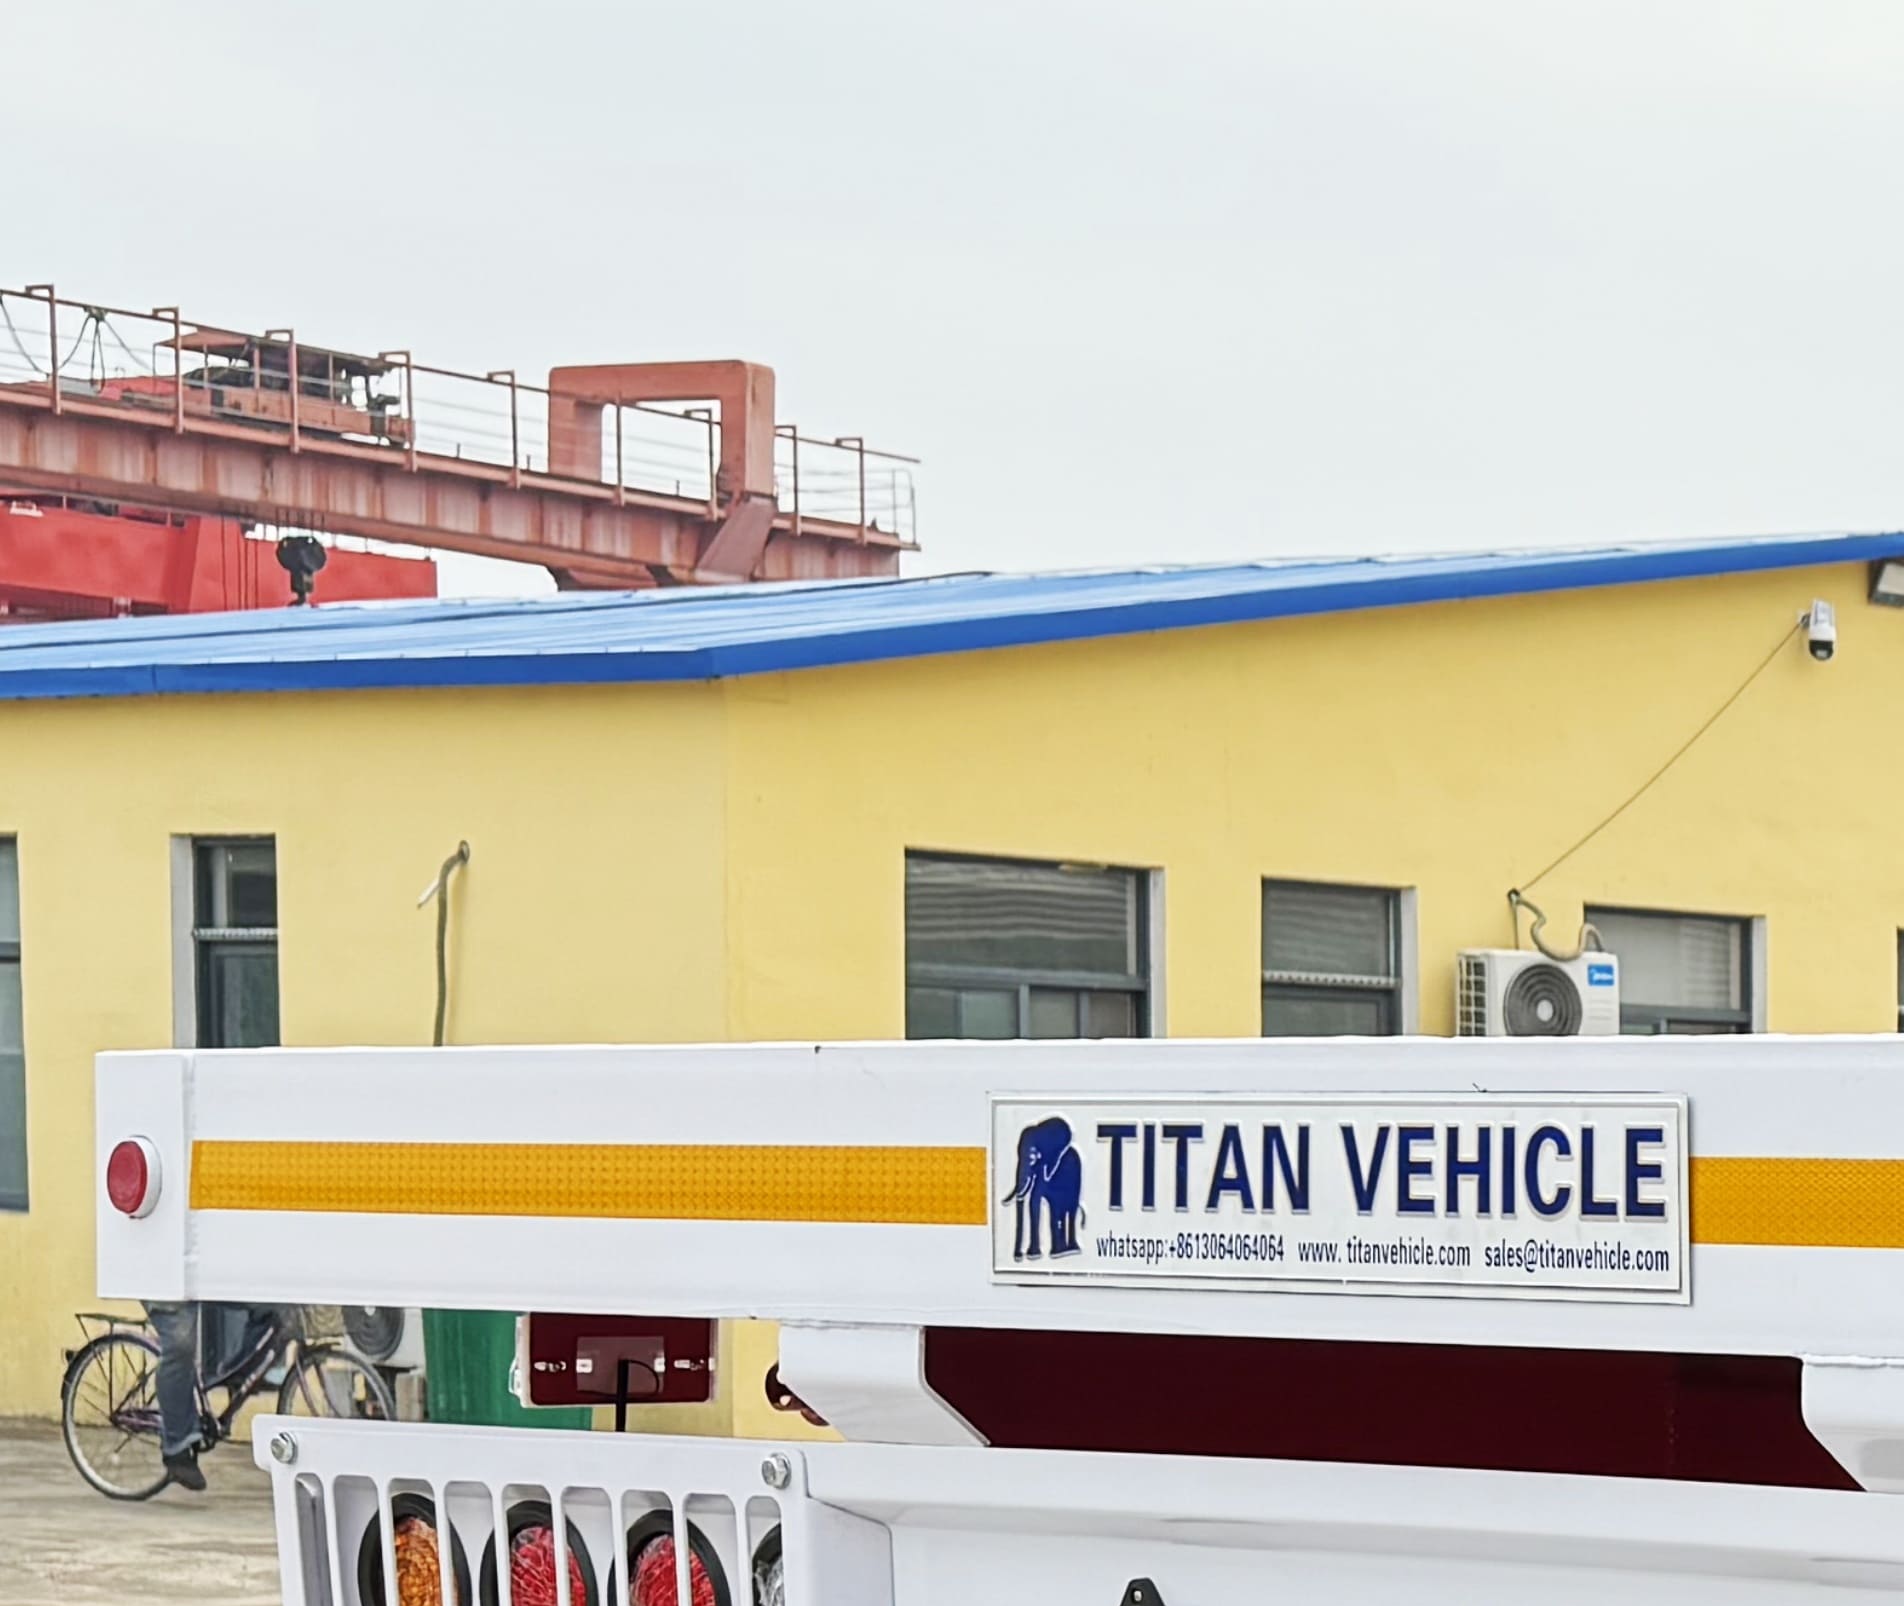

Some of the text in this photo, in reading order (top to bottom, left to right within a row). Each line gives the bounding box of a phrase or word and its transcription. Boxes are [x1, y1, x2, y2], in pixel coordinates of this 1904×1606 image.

[1097, 1124, 1666, 1217] TITAN VEHICLE
[1484, 1238, 1670, 1273] sales@titanvehicle.com
